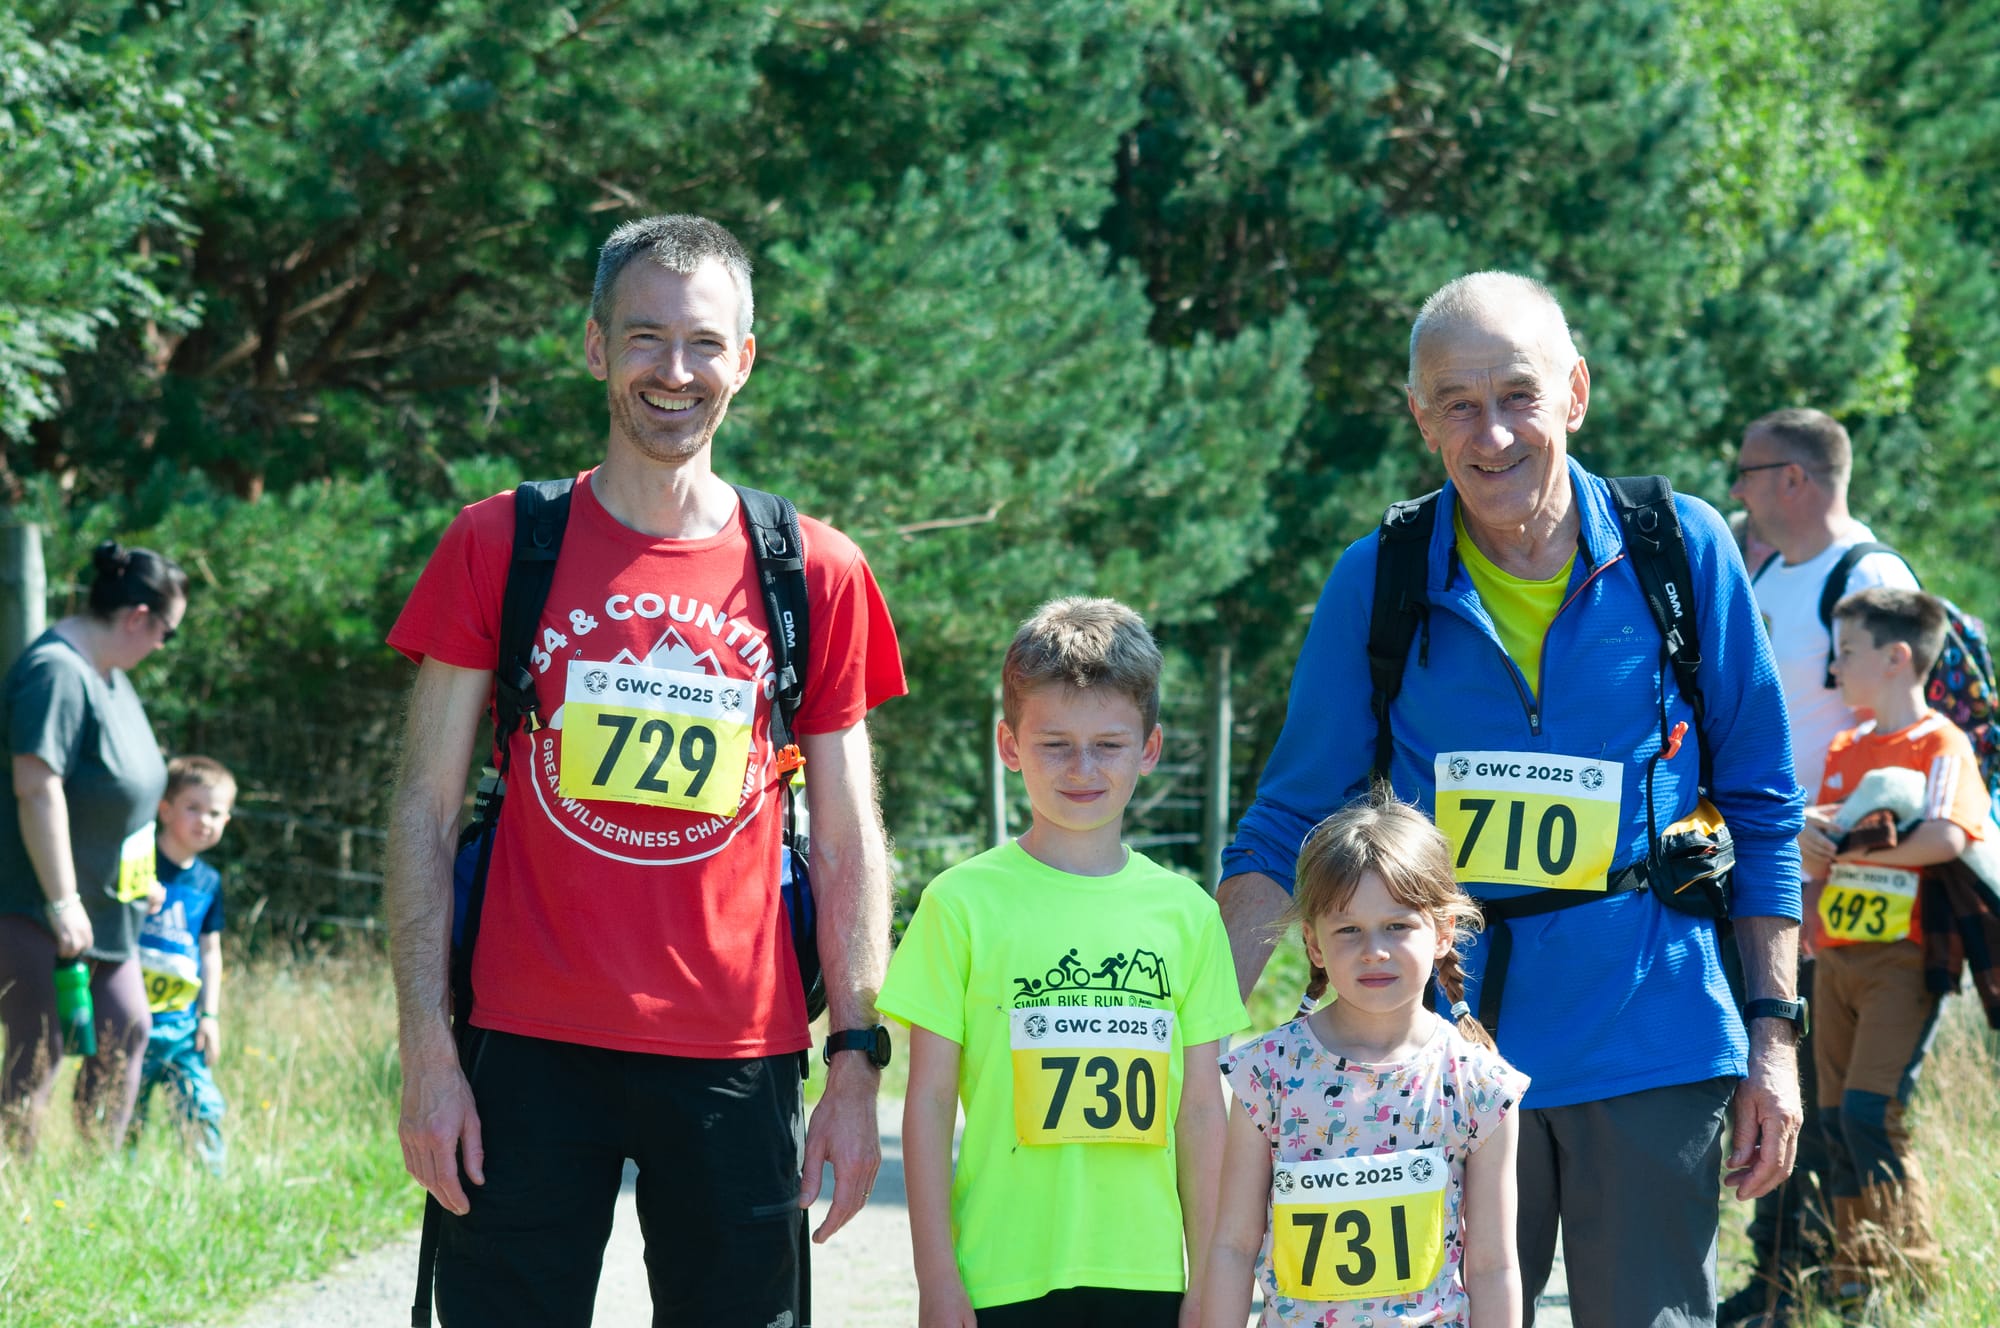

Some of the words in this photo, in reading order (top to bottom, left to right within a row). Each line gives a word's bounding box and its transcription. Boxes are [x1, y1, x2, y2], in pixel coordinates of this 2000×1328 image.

[1665, 582, 1683, 618] OMM
[530, 627, 568, 673] 34
[569, 609, 599, 636] &
[605, 592, 777, 701] COUNTING
[783, 610, 796, 648] OMM
[616, 678, 662, 696] GWC
[667, 684, 714, 704] 2025
[591, 713, 717, 798] 729
[1476, 762, 1521, 778] GWC
[1526, 765, 1573, 783] 2025
[561, 797, 681, 848] WILDERNESS
[685, 761, 759, 843] CHALENGE
[1455, 798, 1577, 876] 710
[1828, 891, 1888, 936] 693
[143, 969, 184, 1004] 92
[1014, 997, 1051, 1010] SWIM
[1058, 994, 1089, 1007] BIKE
[1094, 994, 1124, 1008] RUN
[1055, 1019, 1101, 1034] GWC
[1108, 1019, 1148, 1036] 2025
[1041, 1056, 1156, 1131] 730
[1301, 1172, 1349, 1190] GWC
[1355, 1166, 1403, 1186] 2025
[1292, 1205, 1411, 1287] 731
